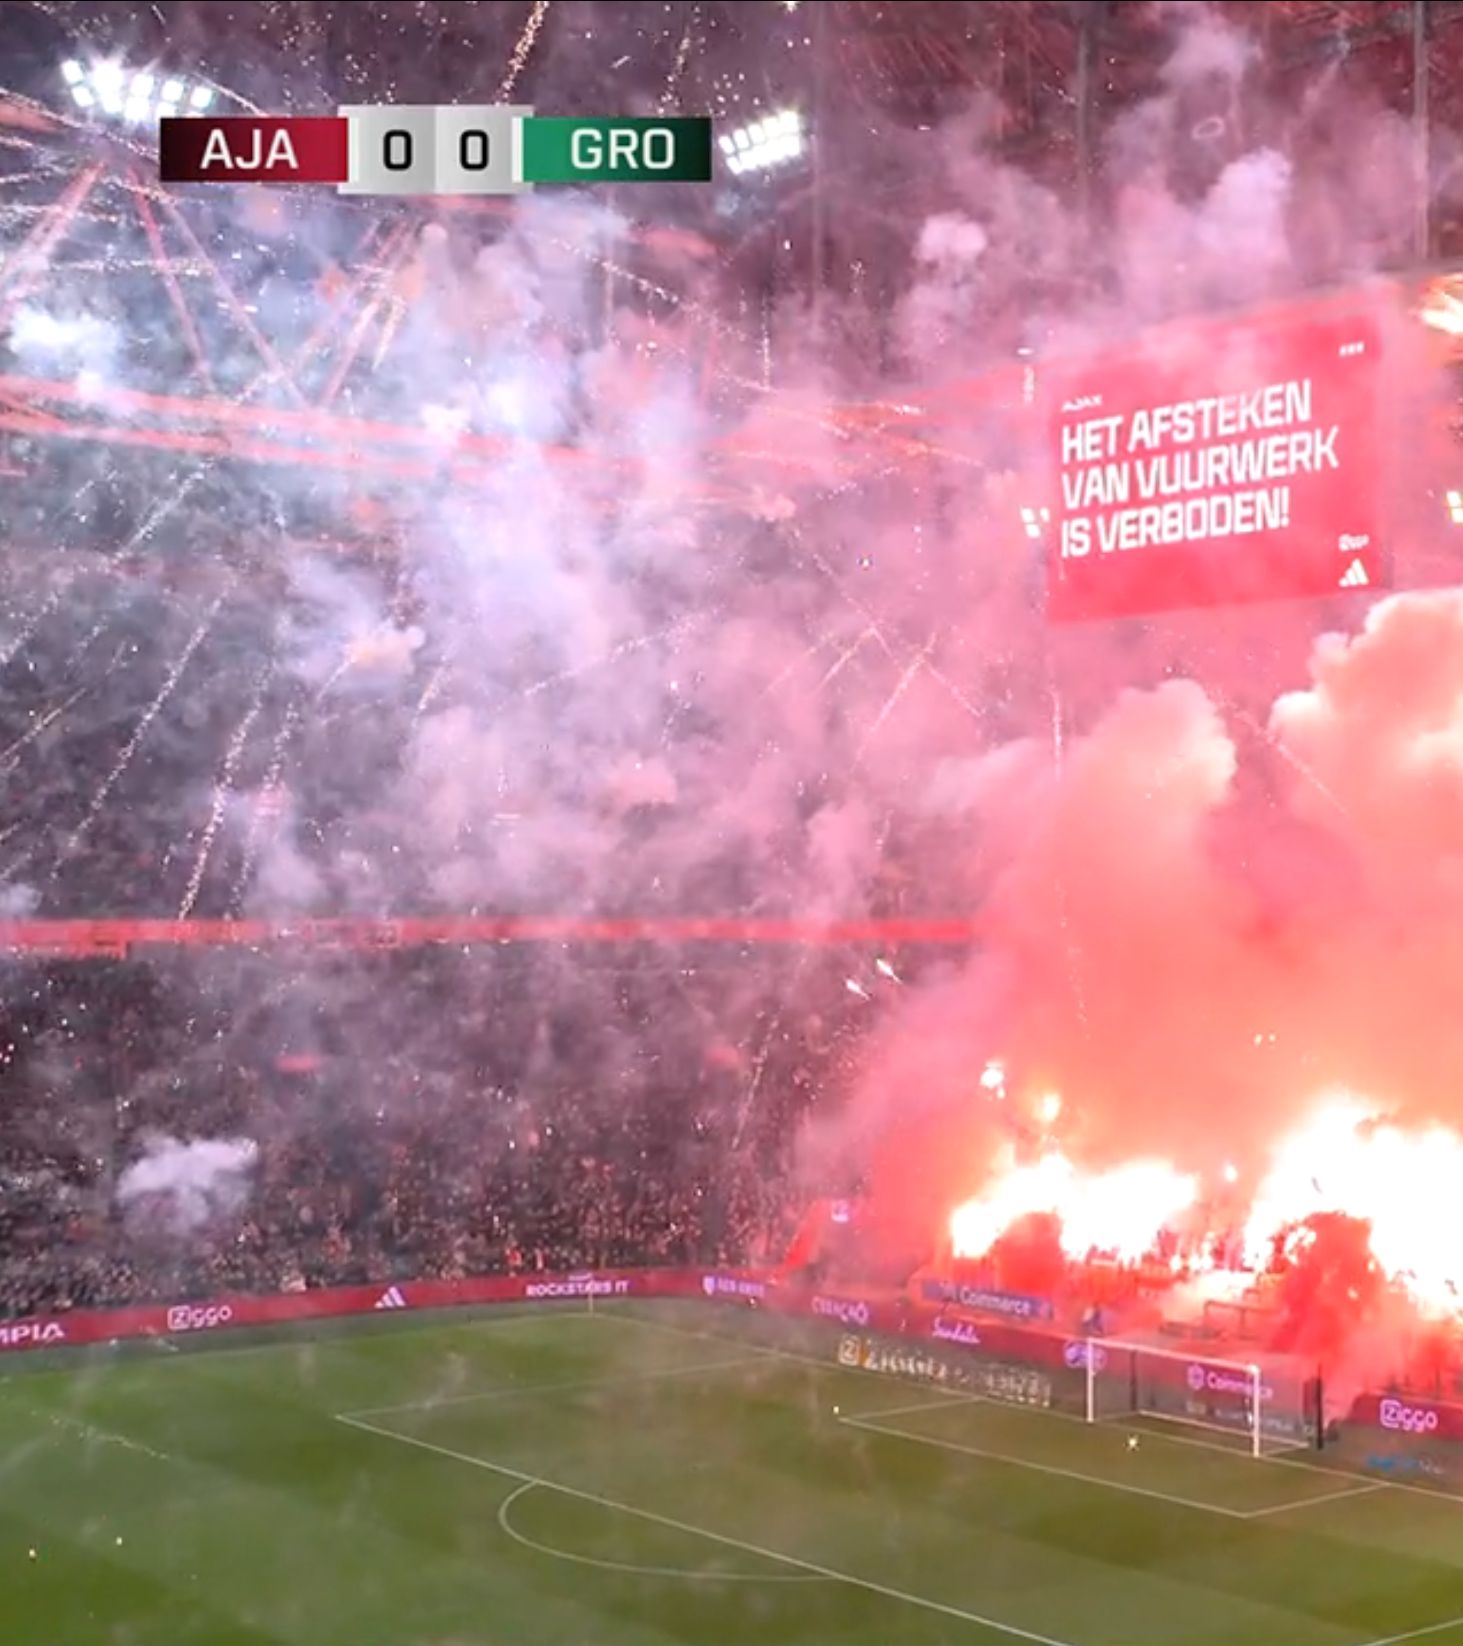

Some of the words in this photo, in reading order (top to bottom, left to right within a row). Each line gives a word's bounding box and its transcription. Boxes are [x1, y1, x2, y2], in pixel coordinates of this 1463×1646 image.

[1062, 415, 1123, 464] HET
[1128, 378, 1311, 452] AFSTEKEN
[1062, 462, 1128, 509] VAN
[1135, 426, 1339, 498] VUURWERK
[1062, 518, 1090, 557] IS
[1097, 487, 1289, 552] VERBODEN!
[525, 1279, 611, 1297] ROCKSTARS
